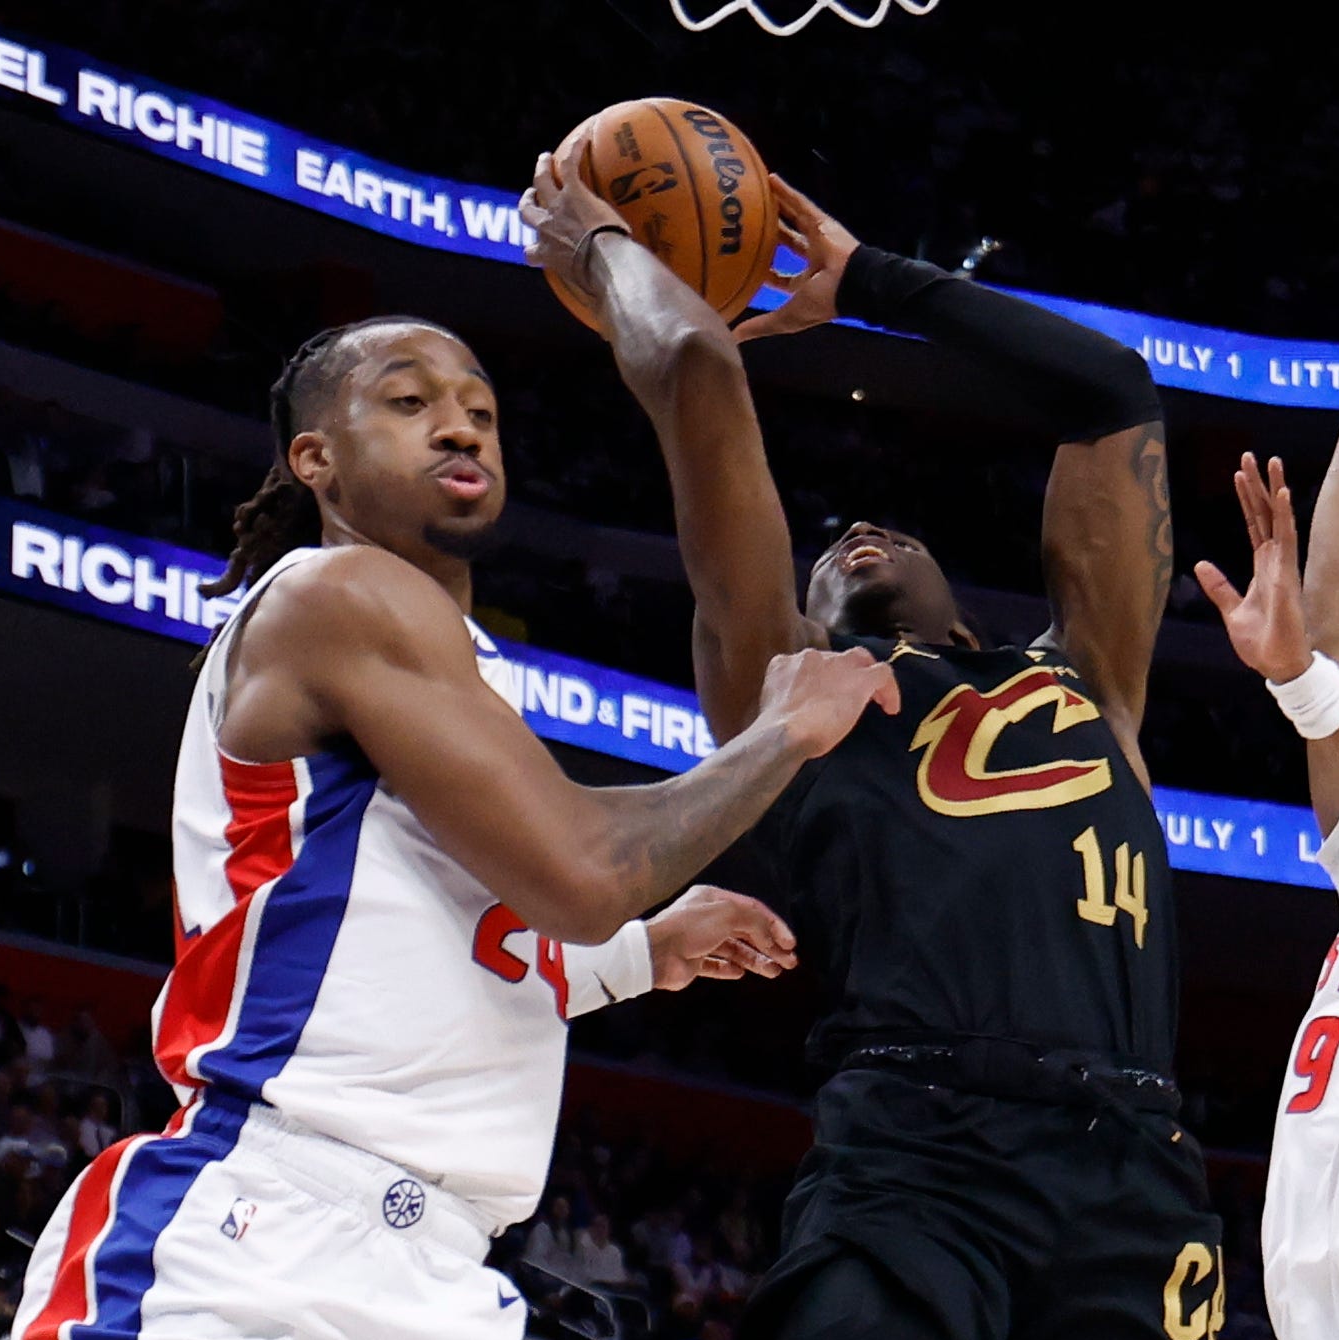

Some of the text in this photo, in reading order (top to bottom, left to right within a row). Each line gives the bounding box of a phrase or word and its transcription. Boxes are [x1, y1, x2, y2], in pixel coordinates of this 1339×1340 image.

[78, 69, 268, 176] RICHIE
[290, 148, 459, 238] EARTH,
[683, 110, 746, 255] Wilson
[1136, 335, 1213, 372] JULY
[1226, 352, 1243, 379] 1
[1072, 825, 1149, 950] 14
[1160, 814, 1235, 851] ULY
[1250, 825, 1267, 857] 1
